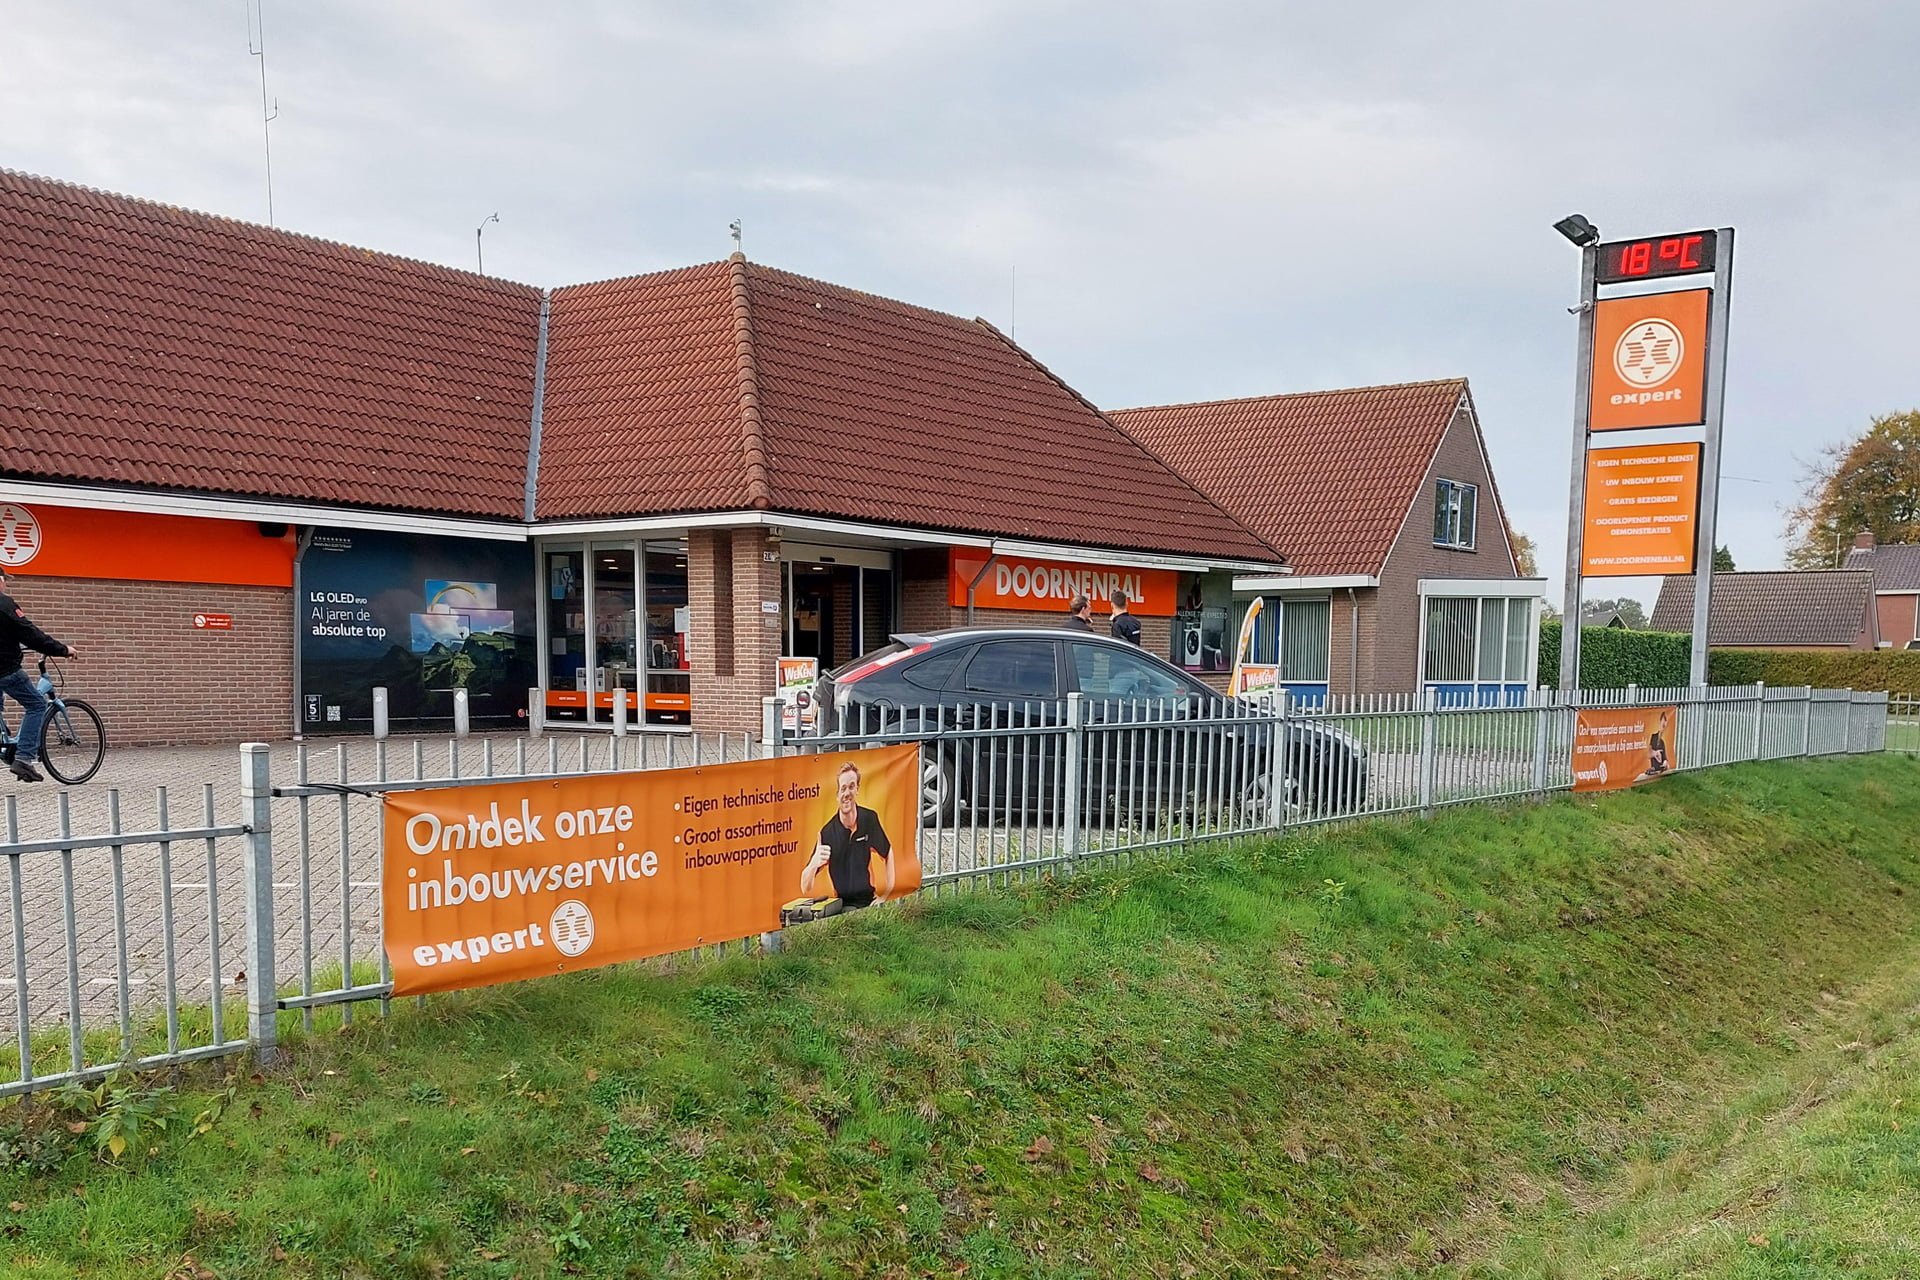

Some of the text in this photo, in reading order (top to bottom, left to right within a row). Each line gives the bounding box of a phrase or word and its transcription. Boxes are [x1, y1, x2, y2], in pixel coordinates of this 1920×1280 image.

[1620, 243, 1651, 275] 18
[1610, 388, 1682, 405] expert
[1597, 454, 1694, 467] EIGEN TECHNISCHE DIENST
[1622, 476, 1655, 486] INBOUW
[1656, 475, 1684, 483] EXPERT
[1608, 495, 1678, 506] GRATIS BEZORGEN
[1595, 514, 1688, 526] DOORLOPENDE PRODUCT
[1610, 526, 1671, 536] DEMONSTRATIES
[1588, 554, 1686, 565] WWW.DOORNENBAL.NL
[995, 563, 1145, 604] DOORNENBAL
[310, 591, 368, 605] LG OLED evo
[311, 606, 371, 624] Al jaren de
[312, 622, 387, 641] absolute top
[309, 703, 317, 715] 5
[683, 782, 821, 817] Eigen technische dienst
[405, 798, 634, 855] Ontdek onze
[683, 816, 793, 846] Groot assortiment
[684, 838, 799, 870] inbouwapparatuur
[407, 841, 659, 912] inbouwservice
[412, 922, 545, 967] expert
